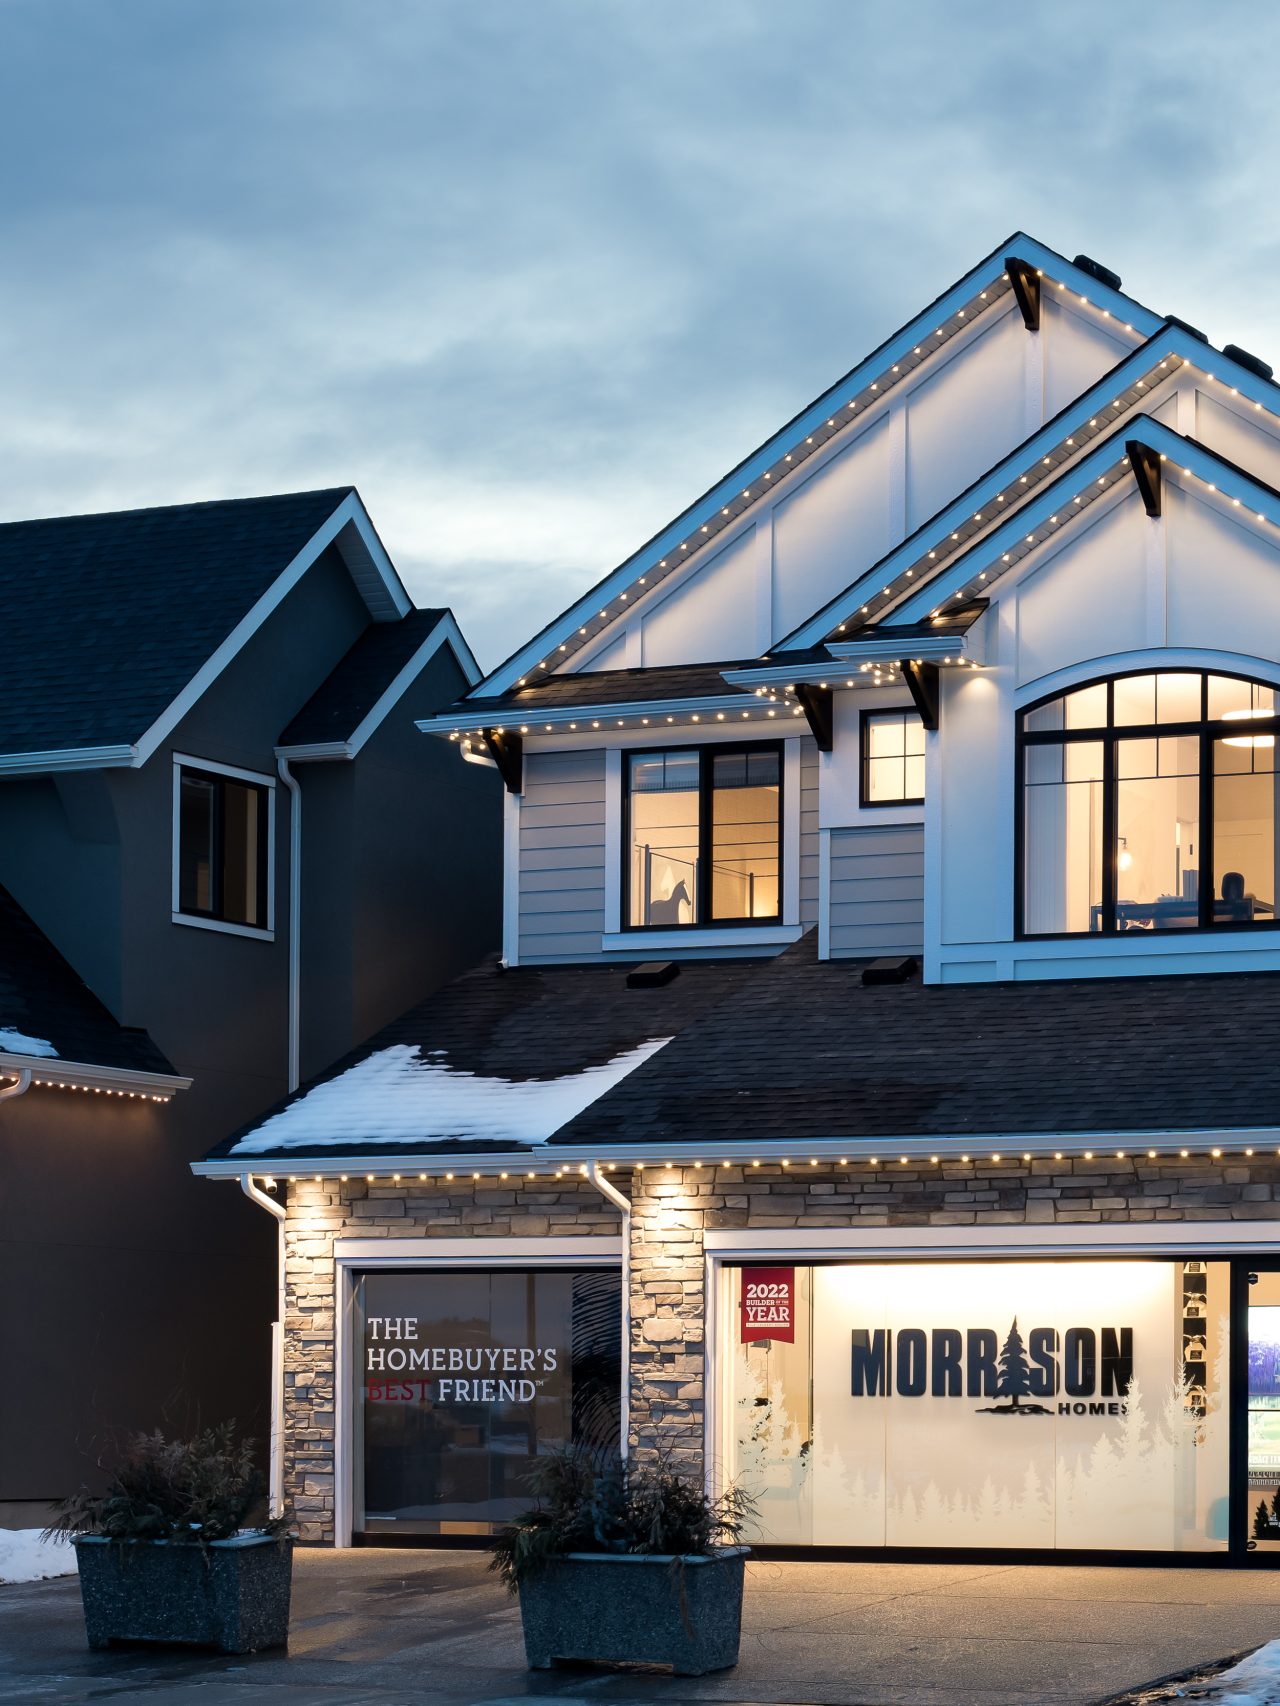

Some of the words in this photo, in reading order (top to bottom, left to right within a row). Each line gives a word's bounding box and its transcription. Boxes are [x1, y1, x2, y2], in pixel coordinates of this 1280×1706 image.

[746, 1284, 789, 1298] 2022
[746, 1306, 790, 1321] YEAR
[367, 1317, 418, 1340] THE
[367, 1348, 557, 1371] HOMEBUYER'S
[367, 1378, 431, 1401] BEST
